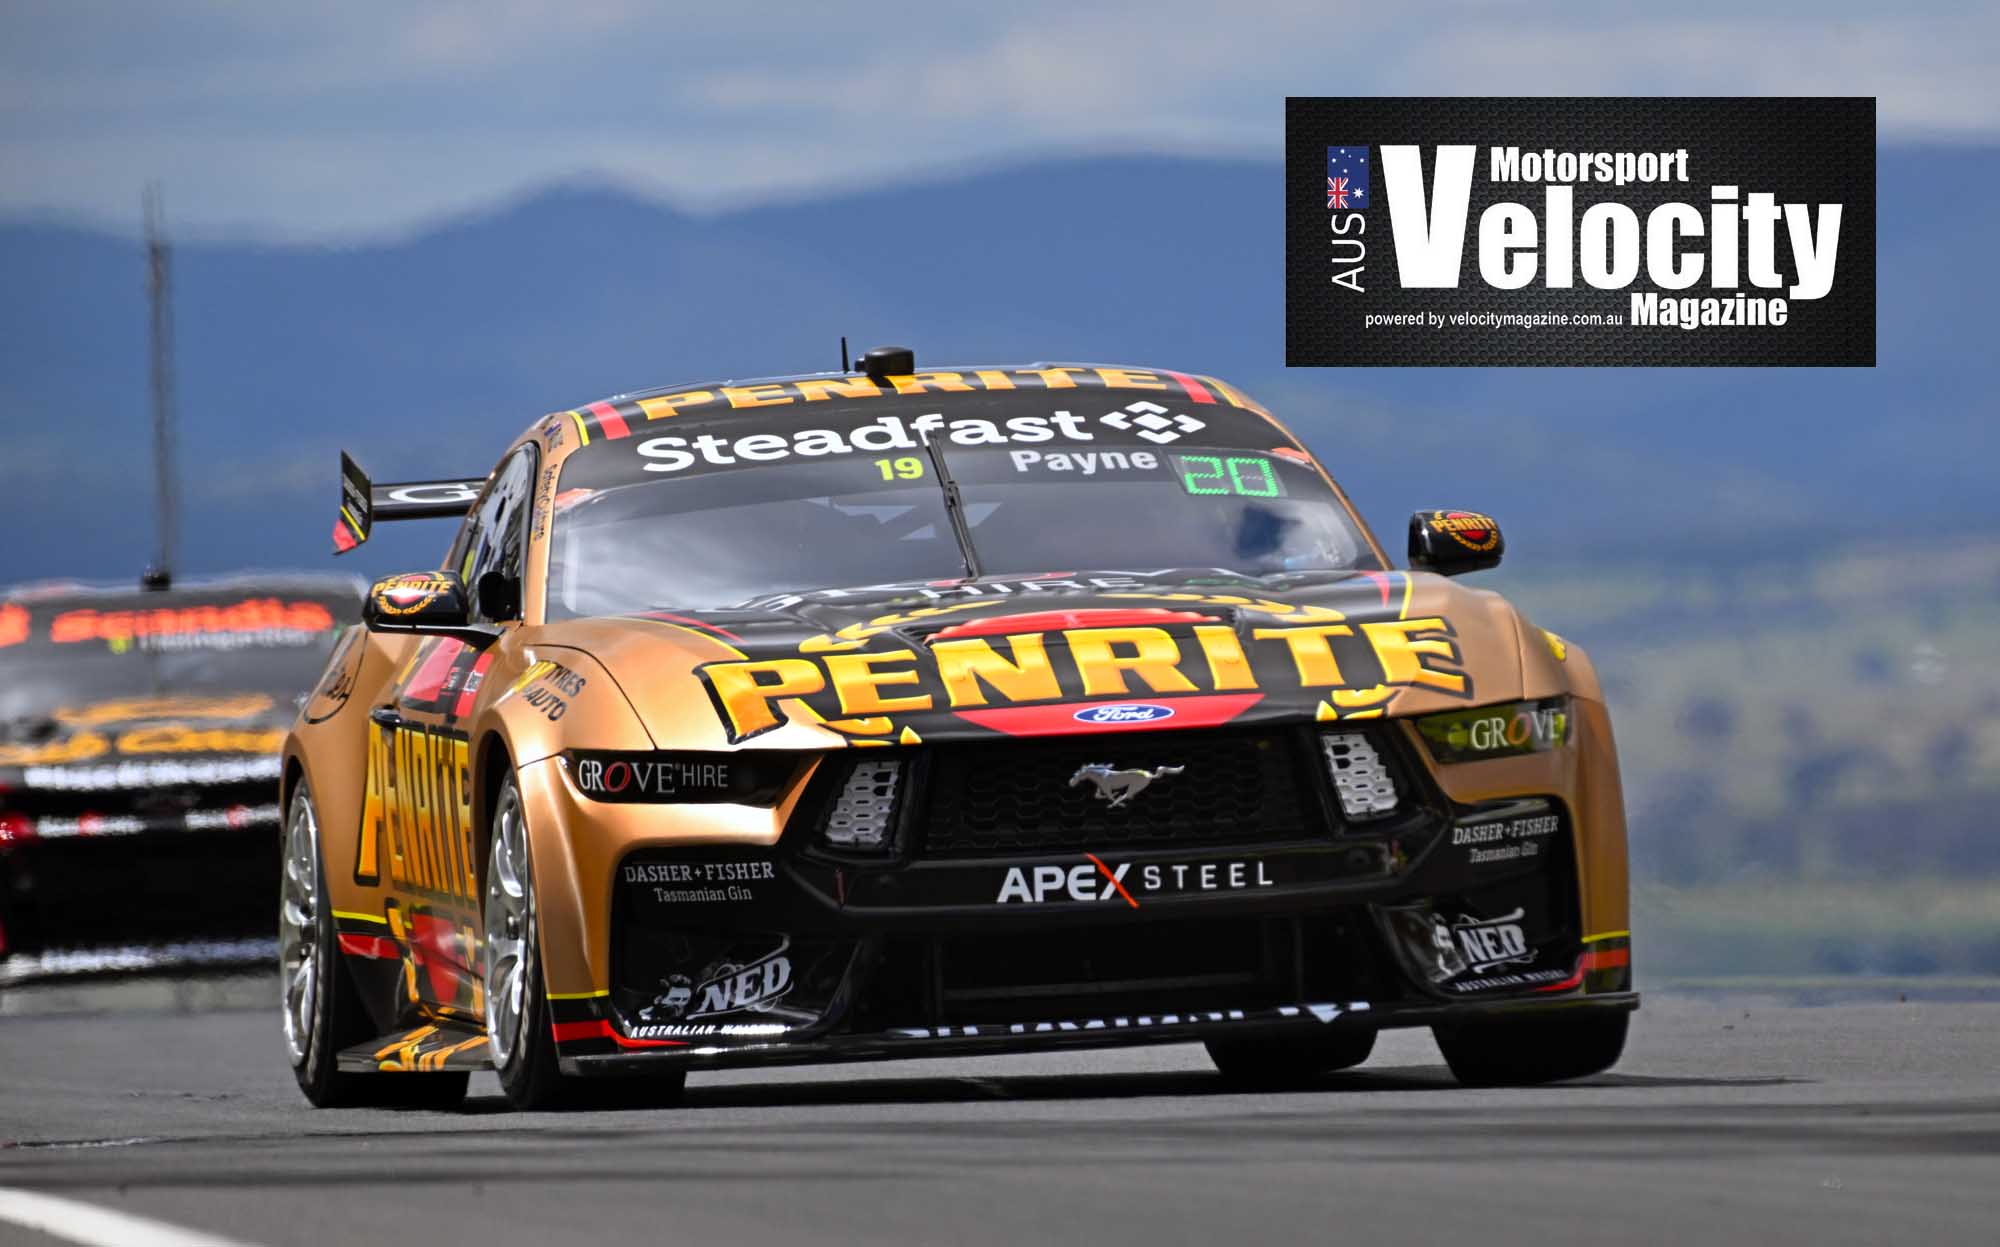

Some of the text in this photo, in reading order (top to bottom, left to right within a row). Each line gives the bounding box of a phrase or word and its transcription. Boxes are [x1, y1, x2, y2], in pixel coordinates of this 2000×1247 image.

[635, 367, 1168, 420] PENRITE
[636, 411, 1094, 472] Steadfast
[873, 457, 924, 481] 19
[1009, 450, 1159, 475] Payne
[1180, 456, 1279, 497] 20
[700, 616, 1470, 742] PENRITE
[1092, 706, 1154, 721] Ford
[578, 760, 729, 794] GROVE HIRE
[1452, 822, 1504, 846] DASHER
[1511, 815, 1559, 838] FISHER
[624, 864, 693, 883] DASHER
[704, 862, 775, 881] FISHER
[997, 853, 1273, 908] APEX STEEL
[654, 886, 752, 903] Tasmanian Gin
[1457, 924, 1527, 963] NED
[700, 956, 792, 1013] NED
[631, 1024, 716, 1038] AUSTRALIAN
